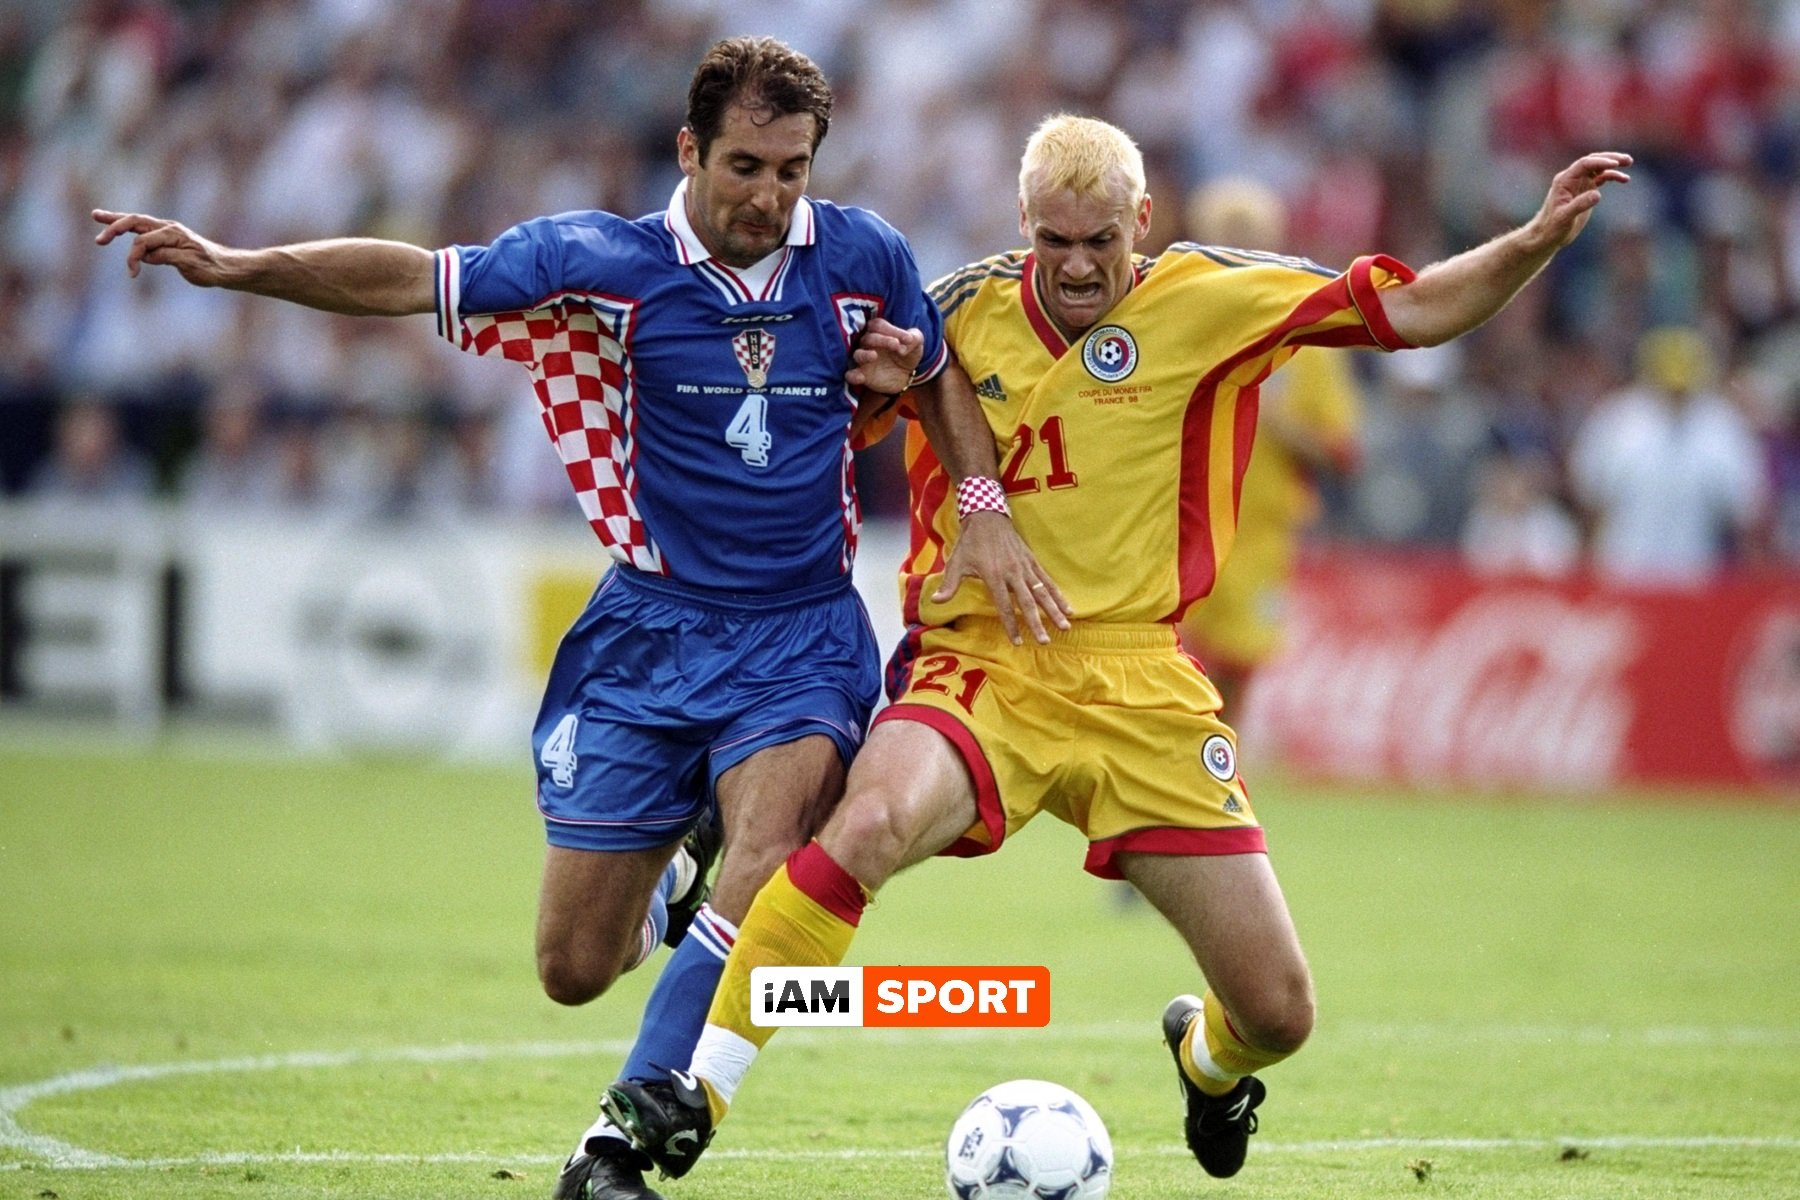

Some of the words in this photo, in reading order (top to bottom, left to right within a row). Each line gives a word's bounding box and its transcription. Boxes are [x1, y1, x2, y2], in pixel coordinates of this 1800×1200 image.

[676, 384, 699, 394] FIFA
[703, 386, 743, 394] WORLD
[770, 387, 811, 395] FRANCE
[814, 387, 827, 396] 98
[1078, 389, 1101, 398] COUPE
[1102, 388, 1112, 396] DU
[1113, 386, 1137, 395] MONDE
[1139, 385, 1153, 393] FIFA
[1094, 396, 1124, 406] FRANCE
[1128, 395, 1139, 403] 98
[725, 394, 771, 467] 4
[1000, 415, 1079, 497] 21
[911, 655, 989, 718] 21
[541, 714, 578, 788] 4
